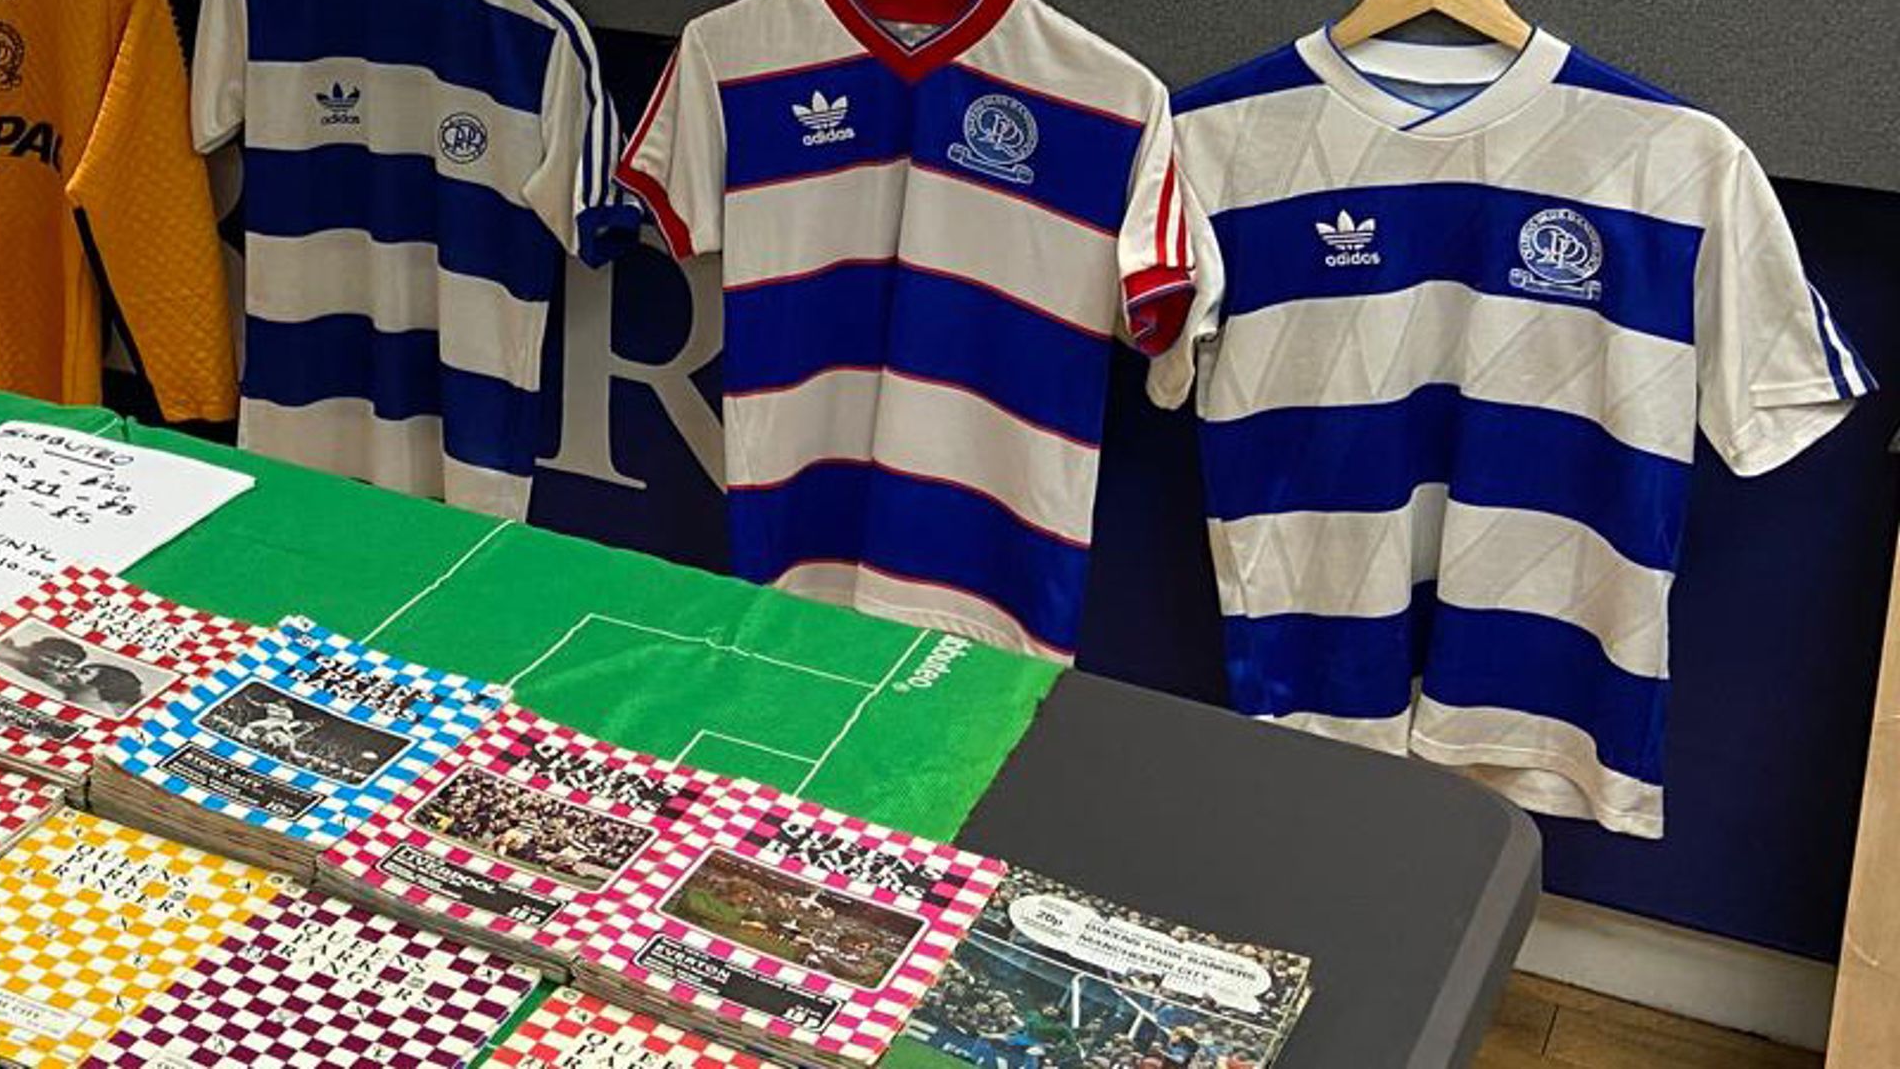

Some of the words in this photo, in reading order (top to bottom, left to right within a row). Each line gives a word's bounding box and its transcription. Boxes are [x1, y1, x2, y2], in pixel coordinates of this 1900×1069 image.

[320, 113, 360, 126] adidas
[802, 128, 856, 147] adidas
[1324, 251, 1381, 268] adidas
[650, 942, 731, 982] EVERTON
